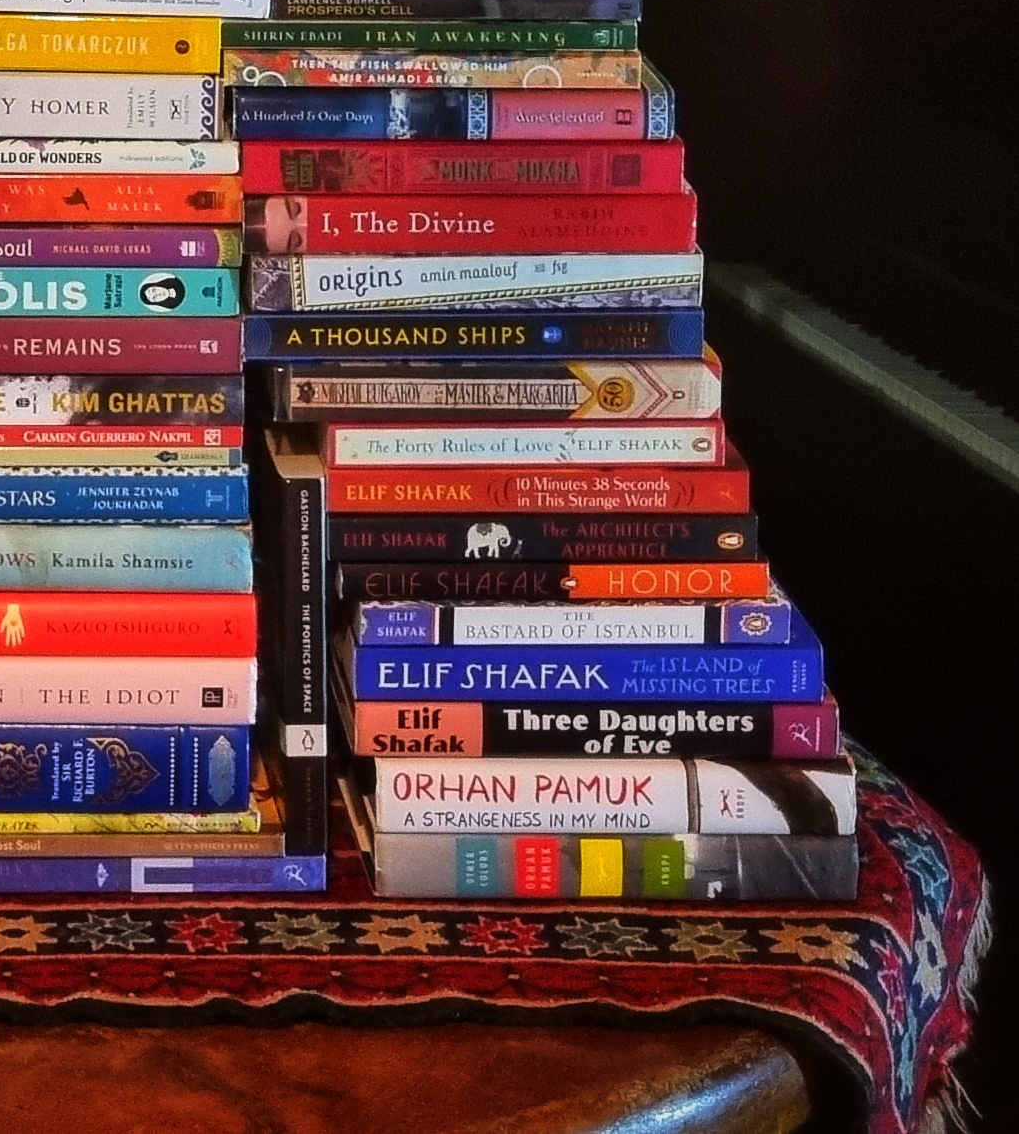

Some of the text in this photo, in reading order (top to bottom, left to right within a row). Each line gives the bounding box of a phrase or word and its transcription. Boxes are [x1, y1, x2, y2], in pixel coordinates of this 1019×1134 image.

[31, 100, 110, 116] HOMER
[19, 151, 36, 163] OF
[39, 151, 102, 163] WONDERS
[321, 213, 495, 236] I, The Divine
[287, 327, 526, 345] A THOUSAND SHIPS
[52, 392, 226, 414] KIM GHATTAS
[346, 485, 472, 501] ELIF SHAFAK
[516, 477, 670, 493] 10 Minutes 38 Seconds
[518, 493, 666, 509] in This Strange World
[609, 570, 733, 594] HONOR
[378, 664, 609, 690] ELIF SHAFAK
[39, 689, 179, 705] THE IDIOT
[397, 709, 442, 729] Elif
[503, 709, 754, 735] Three Daughters
[372, 734, 464, 753] Shafak
[585, 735, 672, 754] of Eve
[394, 773, 654, 804] ORHAN PAMUK
[405, 812, 649, 828] A STRANGENESS IN MY MIND
